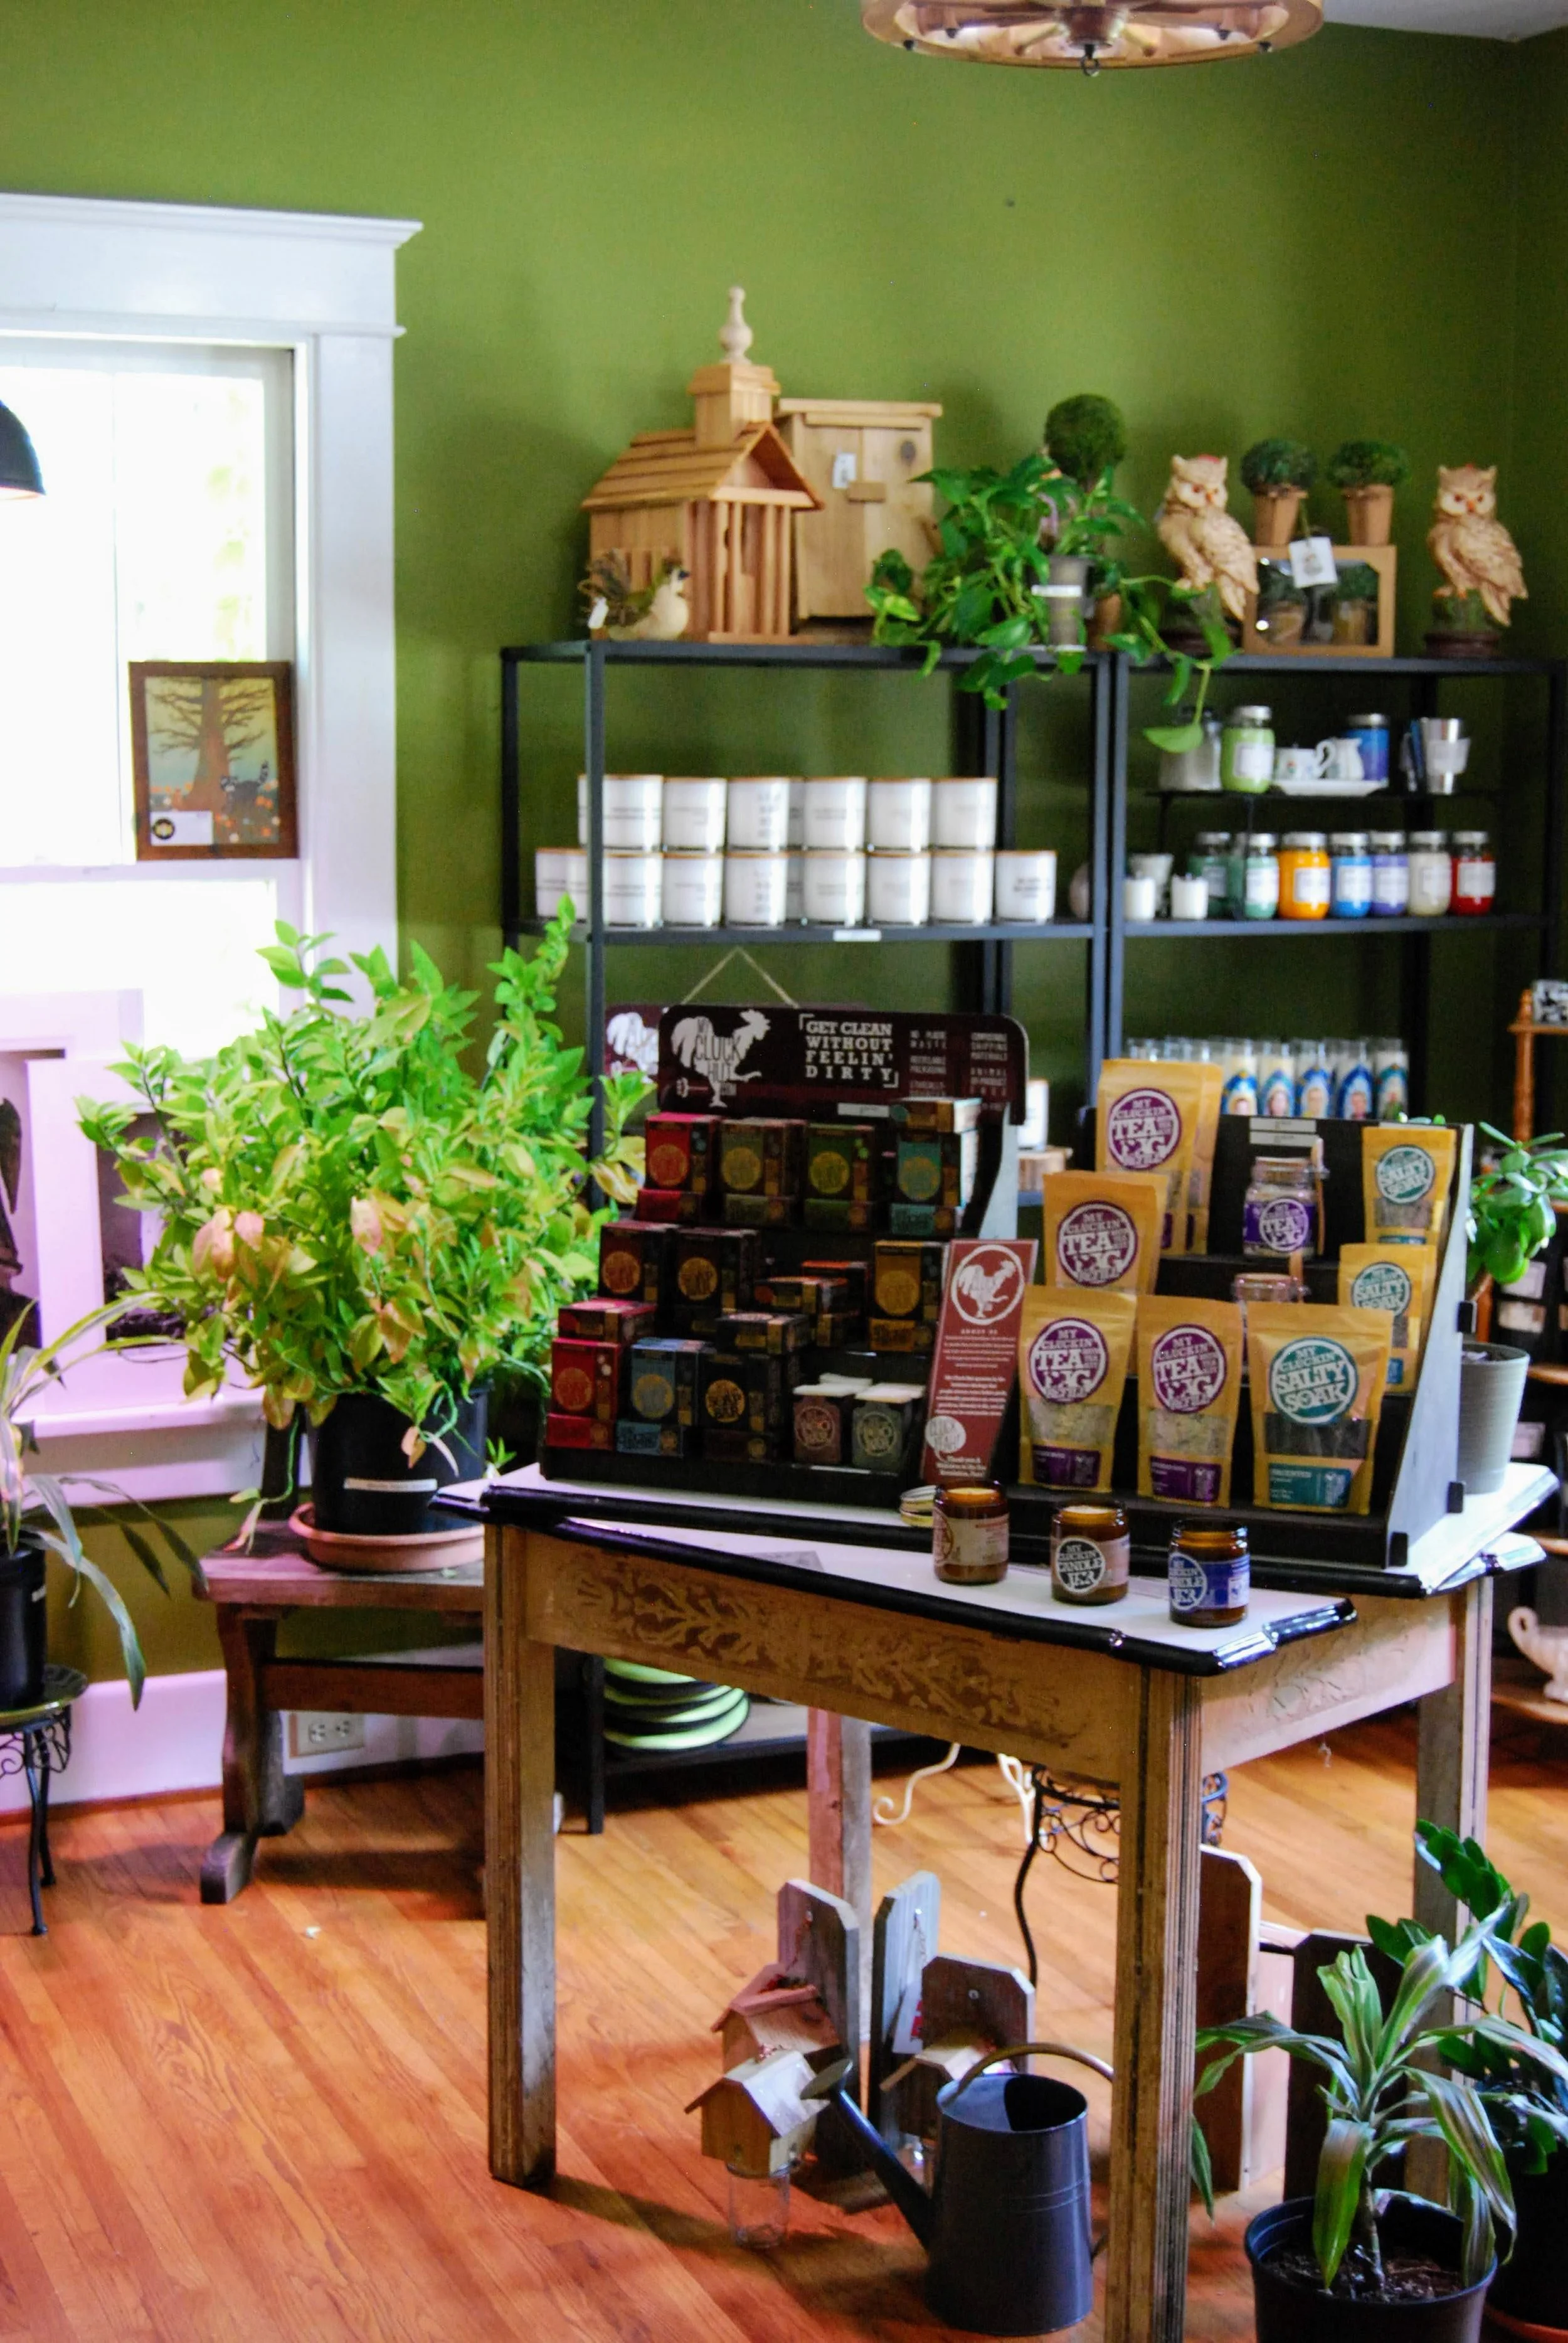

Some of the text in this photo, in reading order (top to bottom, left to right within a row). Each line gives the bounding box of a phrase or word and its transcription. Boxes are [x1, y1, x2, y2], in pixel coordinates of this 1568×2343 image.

[805, 1021, 893, 1036] GET CLEAN
[805, 1035, 893, 1051] WITHOUT
[805, 1049, 893, 1066] FEELIN'
[805, 1065, 893, 1081] DIRTY
[1115, 1117, 1158, 1140] TEA
[1064, 1231, 1113, 1255] TEA
[1036, 1349, 1084, 1370] TEA
[1157, 1355, 1204, 1381] TEA
[1276, 1361, 1347, 1393] SALTY
[1285, 1381, 1348, 1413] SOAK
